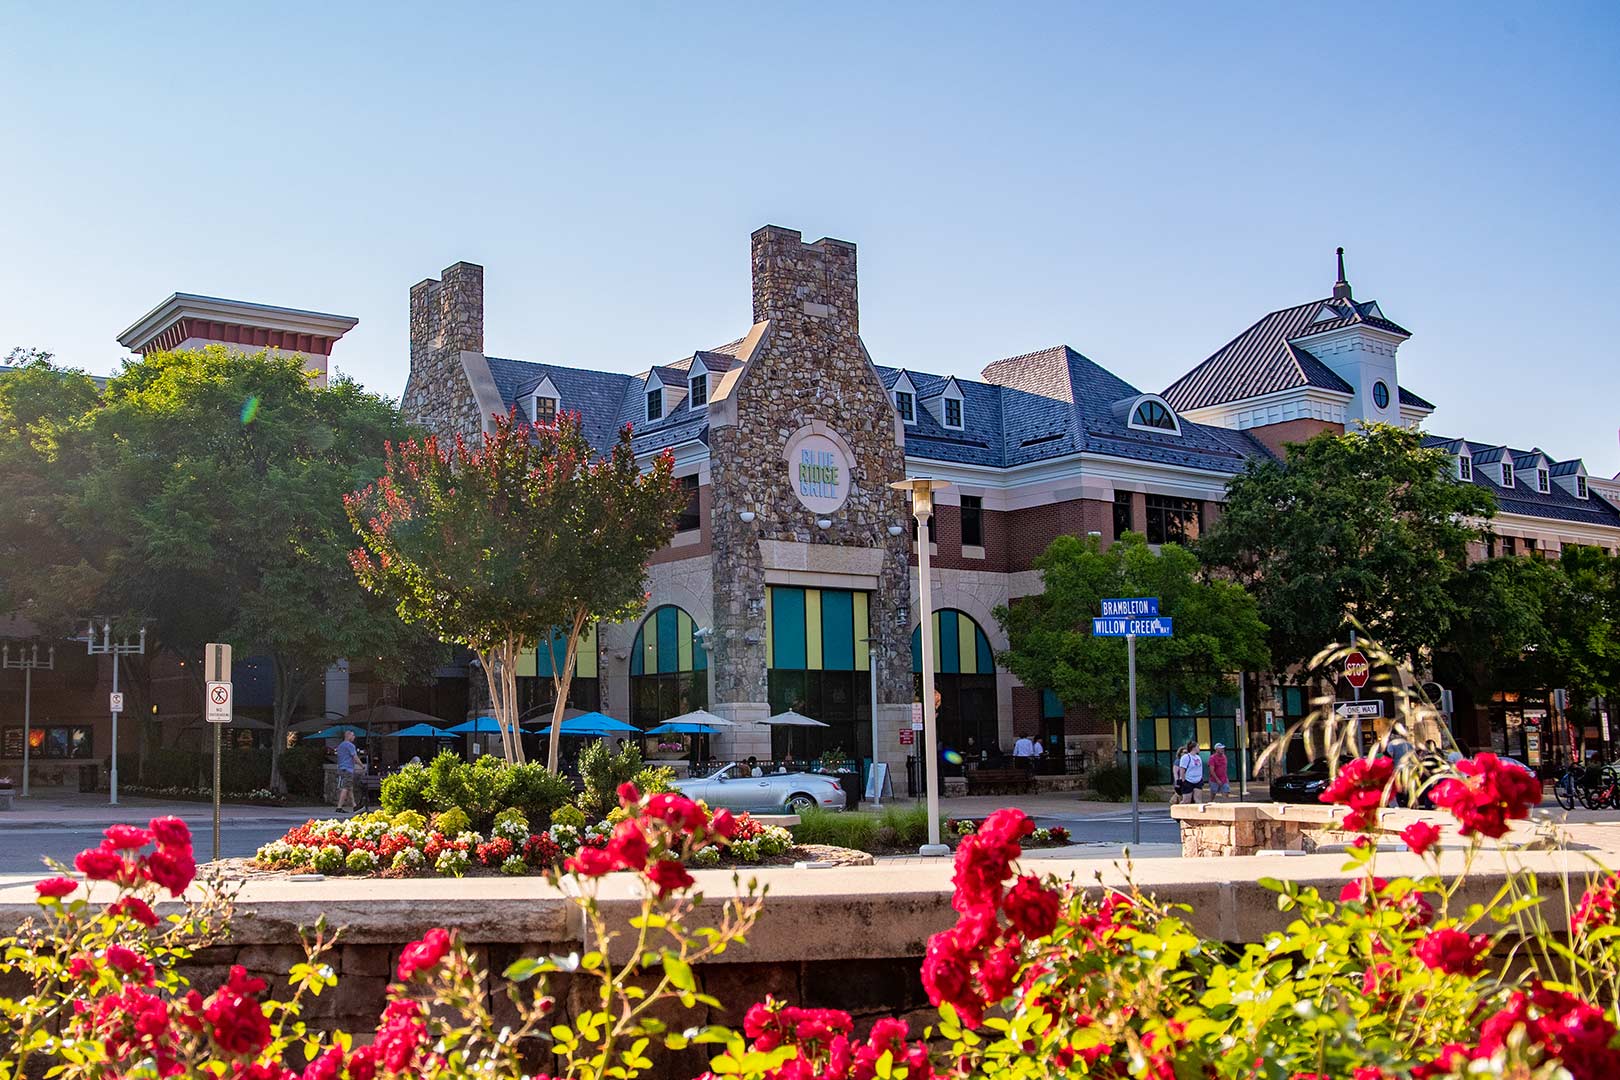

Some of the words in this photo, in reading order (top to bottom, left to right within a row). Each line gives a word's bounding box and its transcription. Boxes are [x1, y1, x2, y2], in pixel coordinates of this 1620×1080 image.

[801, 448, 834, 466] BLUE
[798, 463, 839, 485] RIDGE
[800, 481, 839, 499] GRILL
[1103, 601, 1149, 615] BRAMBLETON
[1095, 620, 1126, 634] WILLOW
[1130, 620, 1156, 634] CREEK
[1346, 663, 1366, 677] STOP
[1347, 706, 1360, 714] ONE
[1362, 705, 1375, 713] WAY
